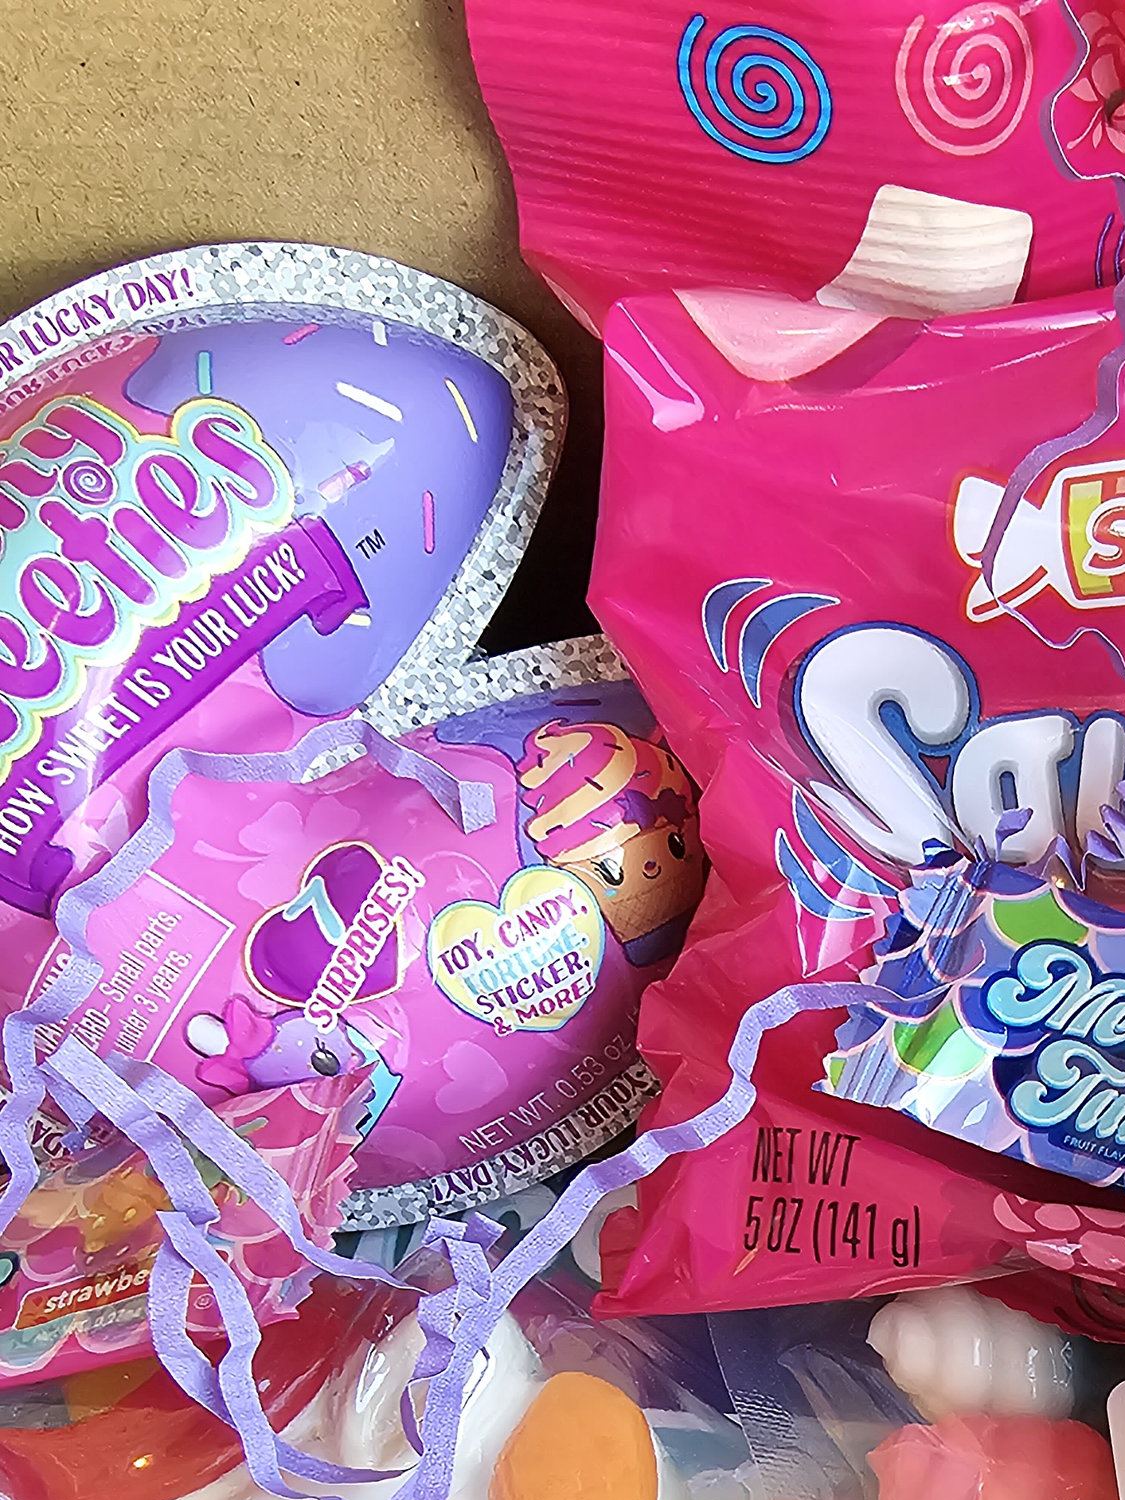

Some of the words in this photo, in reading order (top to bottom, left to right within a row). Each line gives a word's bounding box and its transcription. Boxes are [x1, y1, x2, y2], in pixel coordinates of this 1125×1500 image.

[19, 290, 115, 355] LUCKY
[122, 268, 194, 311] DAY!
[0, 417, 276, 705] eeties
[36, 692, 140, 786] SWEET
[124, 667, 171, 708] IS
[152, 610, 239, 680] YOUR
[221, 543, 305, 627] LUCK?
[99, 950, 146, 1003] Small
[133, 909, 183, 965] parts.
[307, 861, 419, 1029] SURPRISES!
[437, 932, 494, 975] TOY,
[498, 888, 588, 948] CANDY,
[113, 1006, 150, 1054] under
[133, 993, 159, 1013] 3
[146, 950, 193, 1003] years.
[476, 950, 590, 1015] STICKER,
[493, 1016, 512, 1036] &
[515, 972, 593, 1024] MORE!
[458, 1116, 513, 1154] NET
[509, 1092, 561, 1127] WT.
[554, 1056, 605, 1099] 0.53
[1063, 1135, 1096, 1153] FRUIT
[431, 1163, 493, 1201] DAY!
[503, 1123, 581, 1178] LUCKY
[752, 1127, 802, 1183] NET
[808, 1130, 861, 1187] WT
[744, 1196, 764, 1251] 5
[767, 1197, 804, 1253] OZ
[813, 1199, 877, 1263] (141
[891, 1205, 920, 1267] g)
[45, 1268, 150, 1314] strawbe
